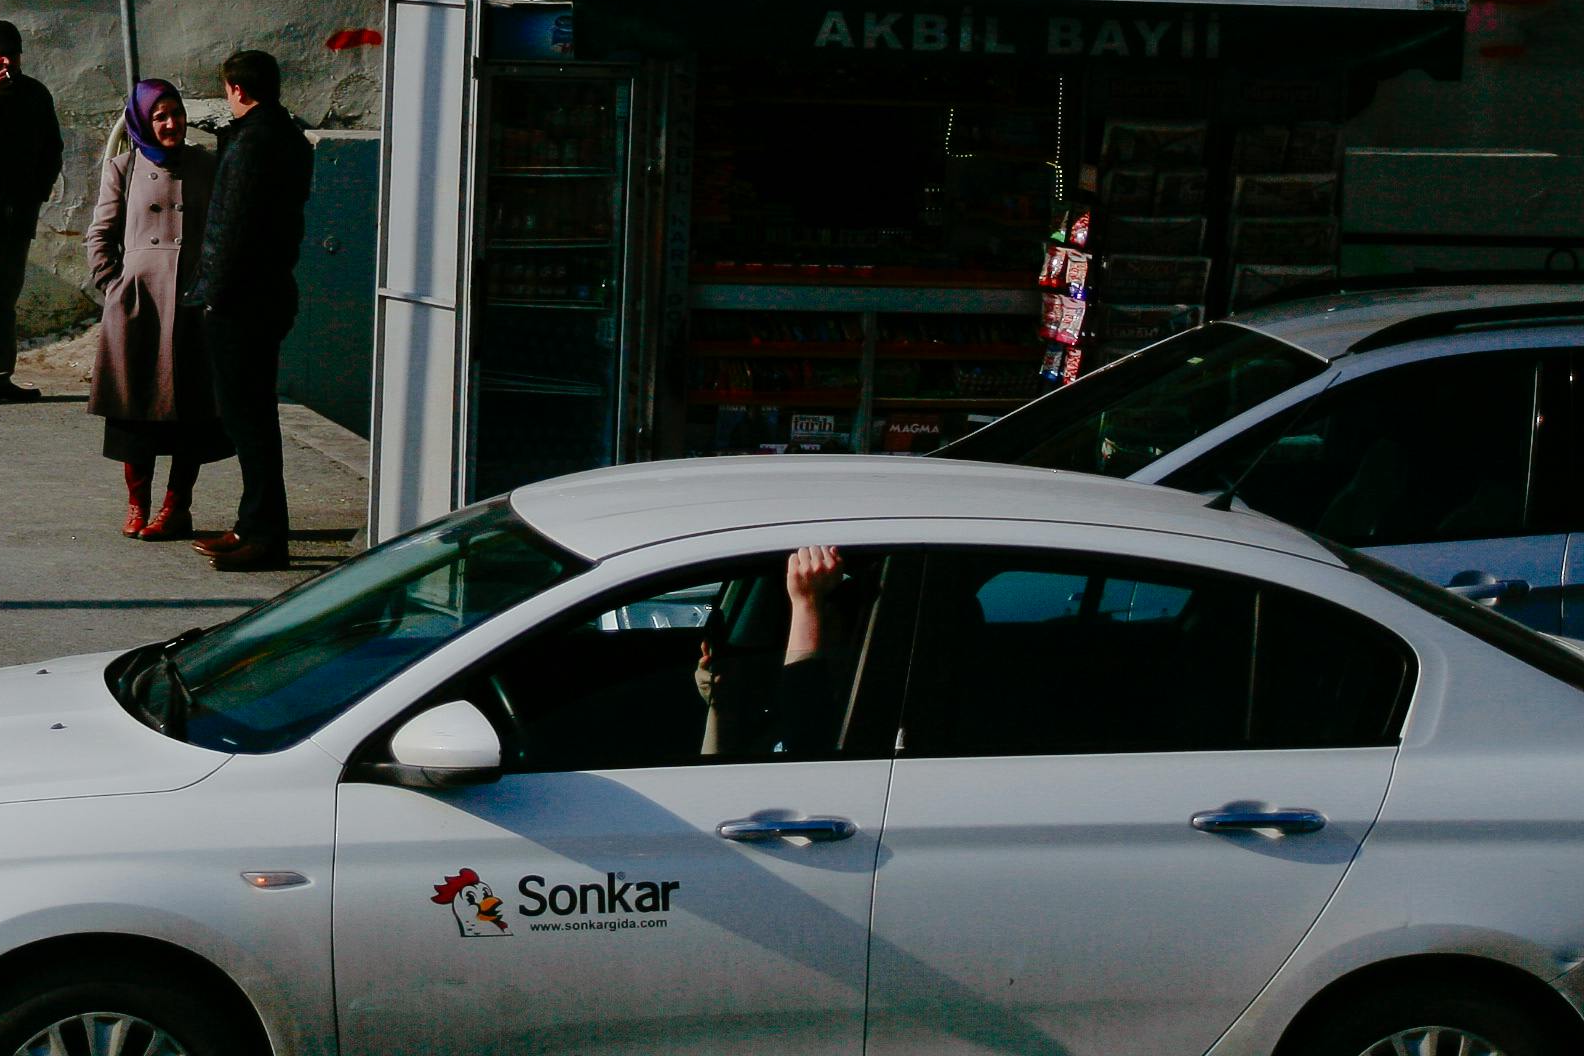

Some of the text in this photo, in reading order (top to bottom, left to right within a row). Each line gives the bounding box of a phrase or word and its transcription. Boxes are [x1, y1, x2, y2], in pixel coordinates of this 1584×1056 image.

[813, 5, 1016, 54] AKBİL
[889, 423, 941, 435] MAGMA
[518, 871, 680, 917] Sonkar
[530, 917, 668, 933] www.sonkargida.com
